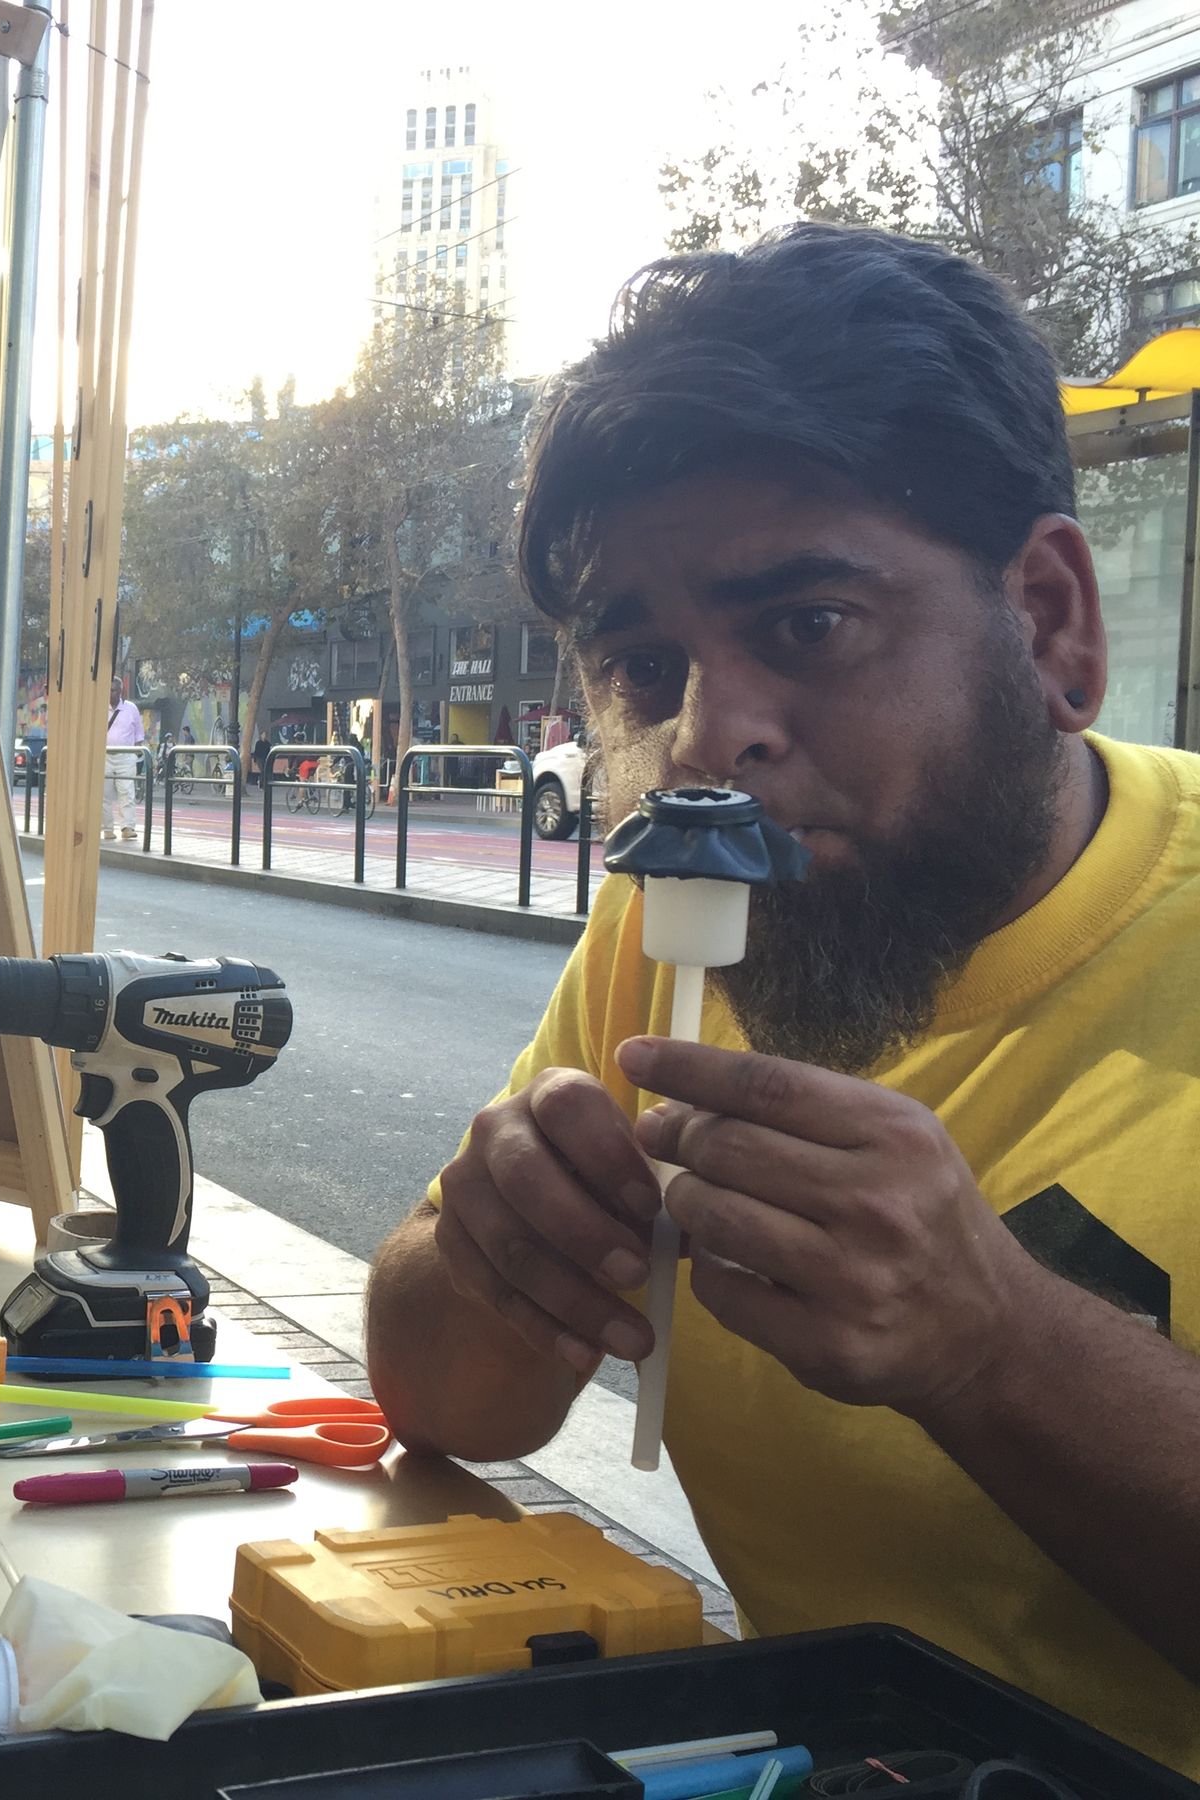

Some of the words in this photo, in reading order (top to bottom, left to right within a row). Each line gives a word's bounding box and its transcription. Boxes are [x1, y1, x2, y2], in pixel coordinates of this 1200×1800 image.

[452, 660, 469, 675] THE
[470, 659, 492, 675] HALL
[450, 684, 495, 702] ENTRANCE
[152, 1007, 231, 1030] Makita
